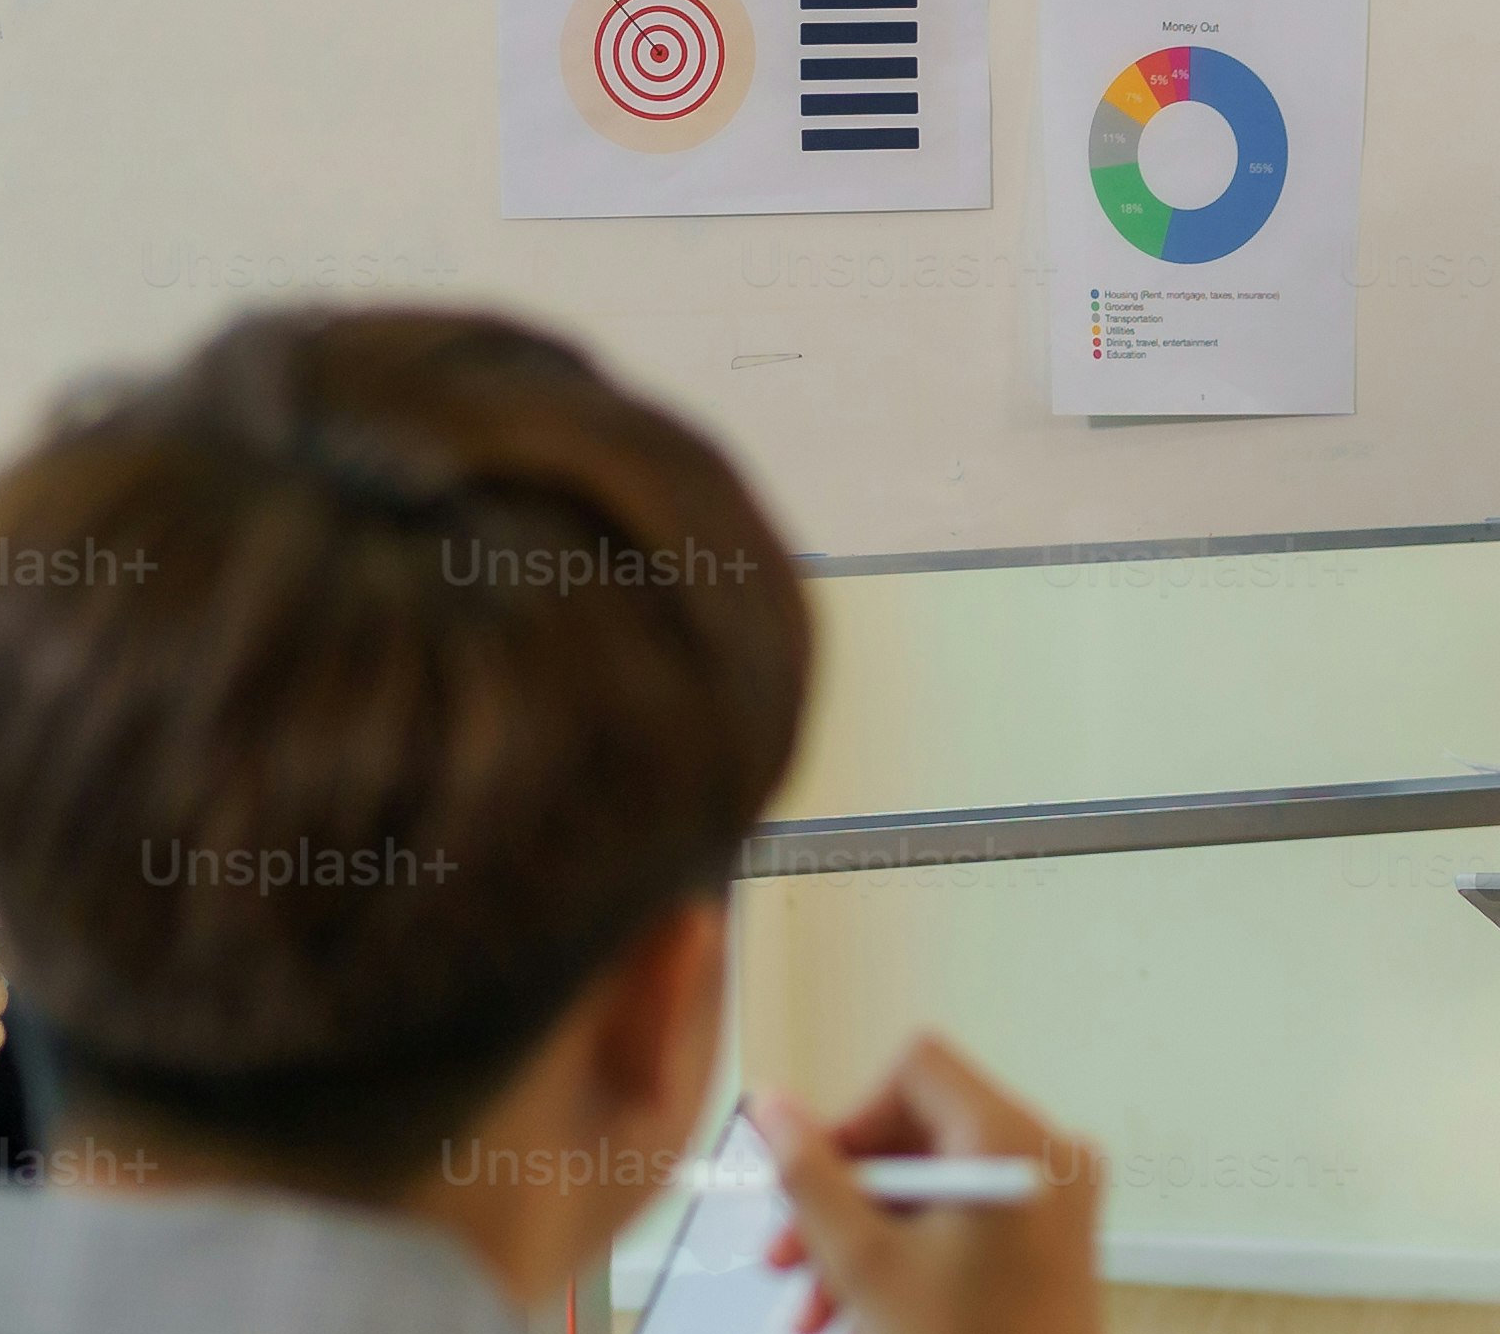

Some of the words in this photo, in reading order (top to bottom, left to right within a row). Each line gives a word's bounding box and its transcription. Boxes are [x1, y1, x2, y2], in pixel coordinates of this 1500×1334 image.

[1162, 21, 1197, 34] Money
[1200, 22, 1219, 33] Out
[1150, 74, 1168, 85] 5%
[1171, 69, 1189, 80] 4%
[1102, 133, 1126, 144] 11%
[1249, 163, 1273, 174] 55%
[1120, 203, 1143, 214] 18%
[1104, 291, 1138, 301] Housing
[1140, 290, 1165, 301] (Rent,
[1167, 291, 1208, 302] mortgage,
[1210, 291, 1235, 301] taxes,
[1237, 291, 1280, 301] insurance)
[1104, 303, 1144, 312] Groceries
[1105, 314, 1163, 324] Transportation
[1106, 326, 1135, 335] Utilities
[1106, 338, 1134, 348] Dining,
[1136, 338, 1160, 348] travel,
[1162, 338, 1218, 347] entertainment
[1106, 350, 1147, 360] Education
